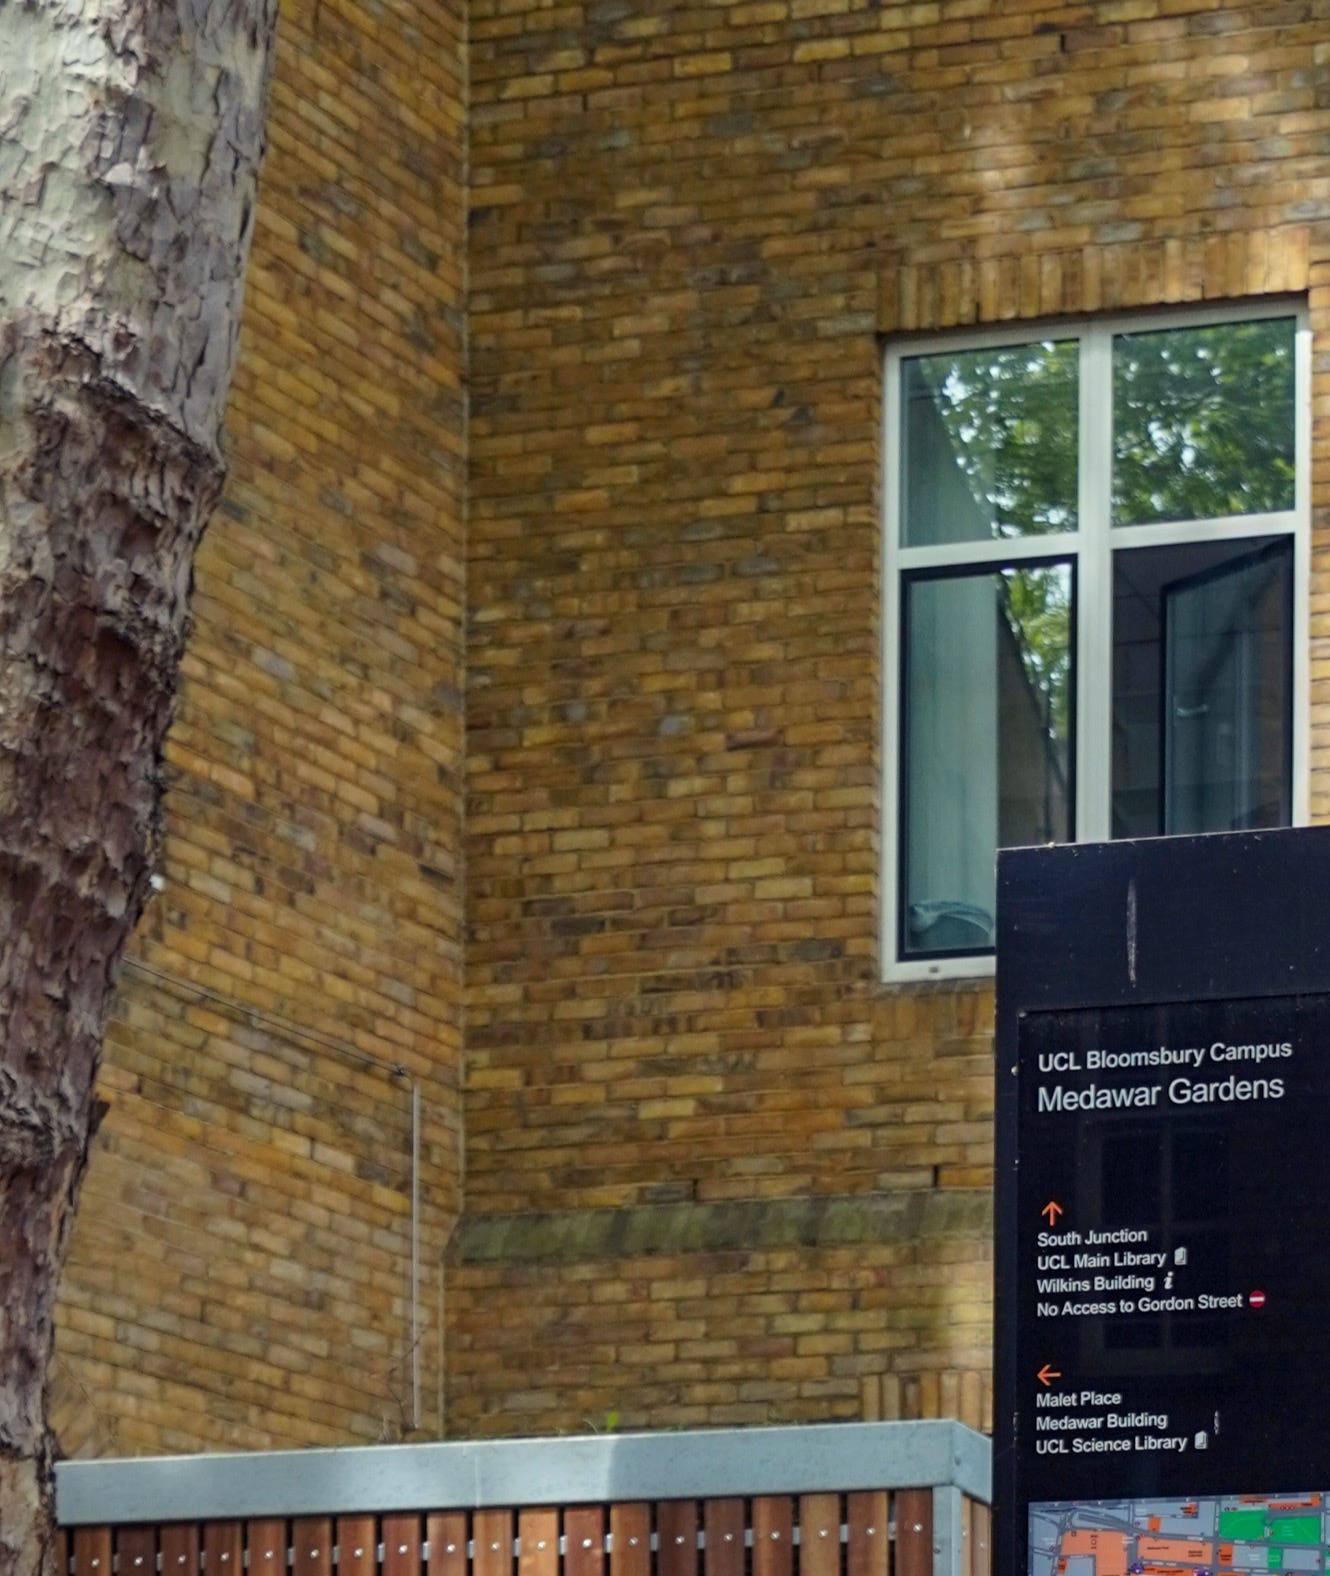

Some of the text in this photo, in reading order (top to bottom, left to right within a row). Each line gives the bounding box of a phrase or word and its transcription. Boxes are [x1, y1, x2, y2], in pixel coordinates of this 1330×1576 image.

[1039, 1043, 1292, 1072] UCL Bloomsbury Campus
[1039, 1076, 1284, 1112] Medawar Gardens
[1038, 1229, 1147, 1247] South Junction
[1038, 1252, 1166, 1270] UCL Main Library
[1037, 1275, 1154, 1293] Wilkins Building
[1038, 1294, 1242, 1316] No Access to Gordon Street
[1037, 1391, 1121, 1407] Malet Place
[1037, 1413, 1167, 1430] Medawar Building
[1037, 1436, 1187, 1454] UCL Science Library
